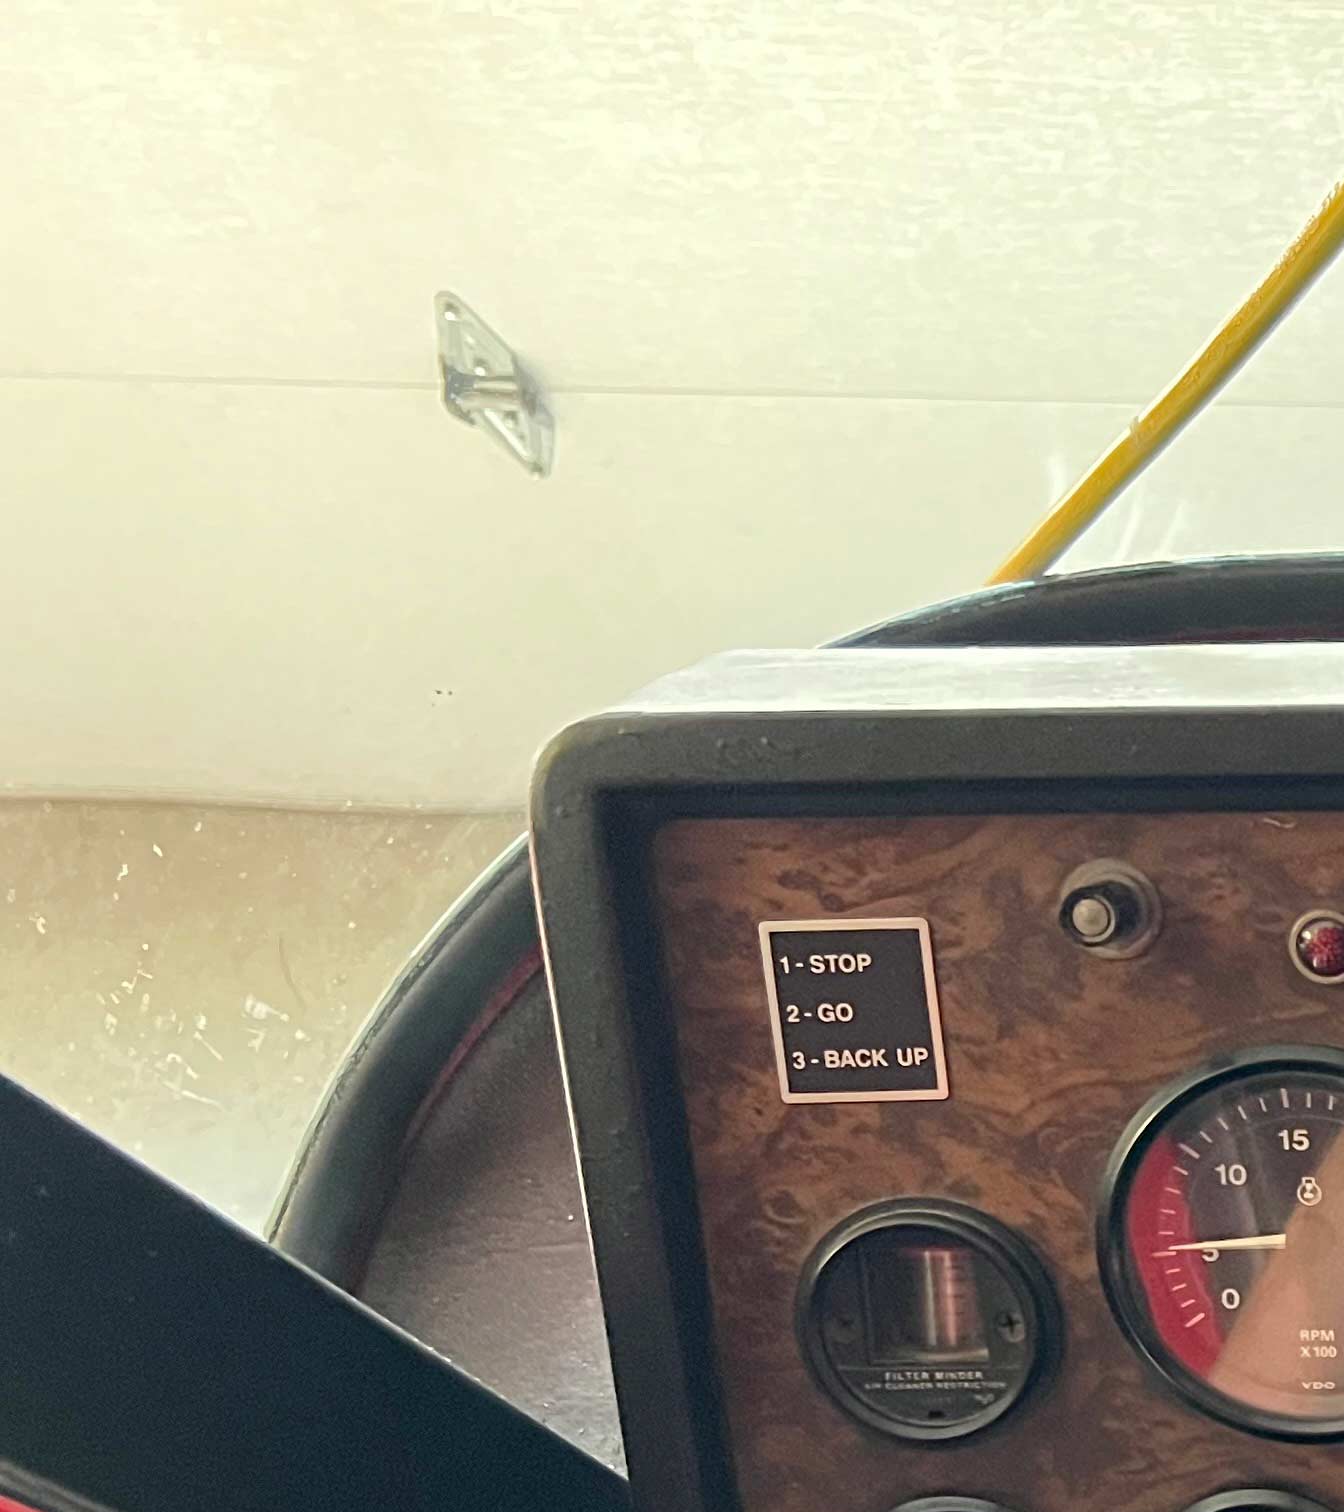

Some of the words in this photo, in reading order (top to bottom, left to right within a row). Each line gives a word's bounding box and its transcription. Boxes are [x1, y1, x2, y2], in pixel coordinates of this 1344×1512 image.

[824, 1049, 888, 1068] BACK
[897, 1047, 929, 1066] UP
[1278, 1129, 1310, 1151] 15
[1214, 1164, 1247, 1186] 10
[1221, 1289, 1240, 1310] 0
[1299, 1330, 1335, 1342] RPM
